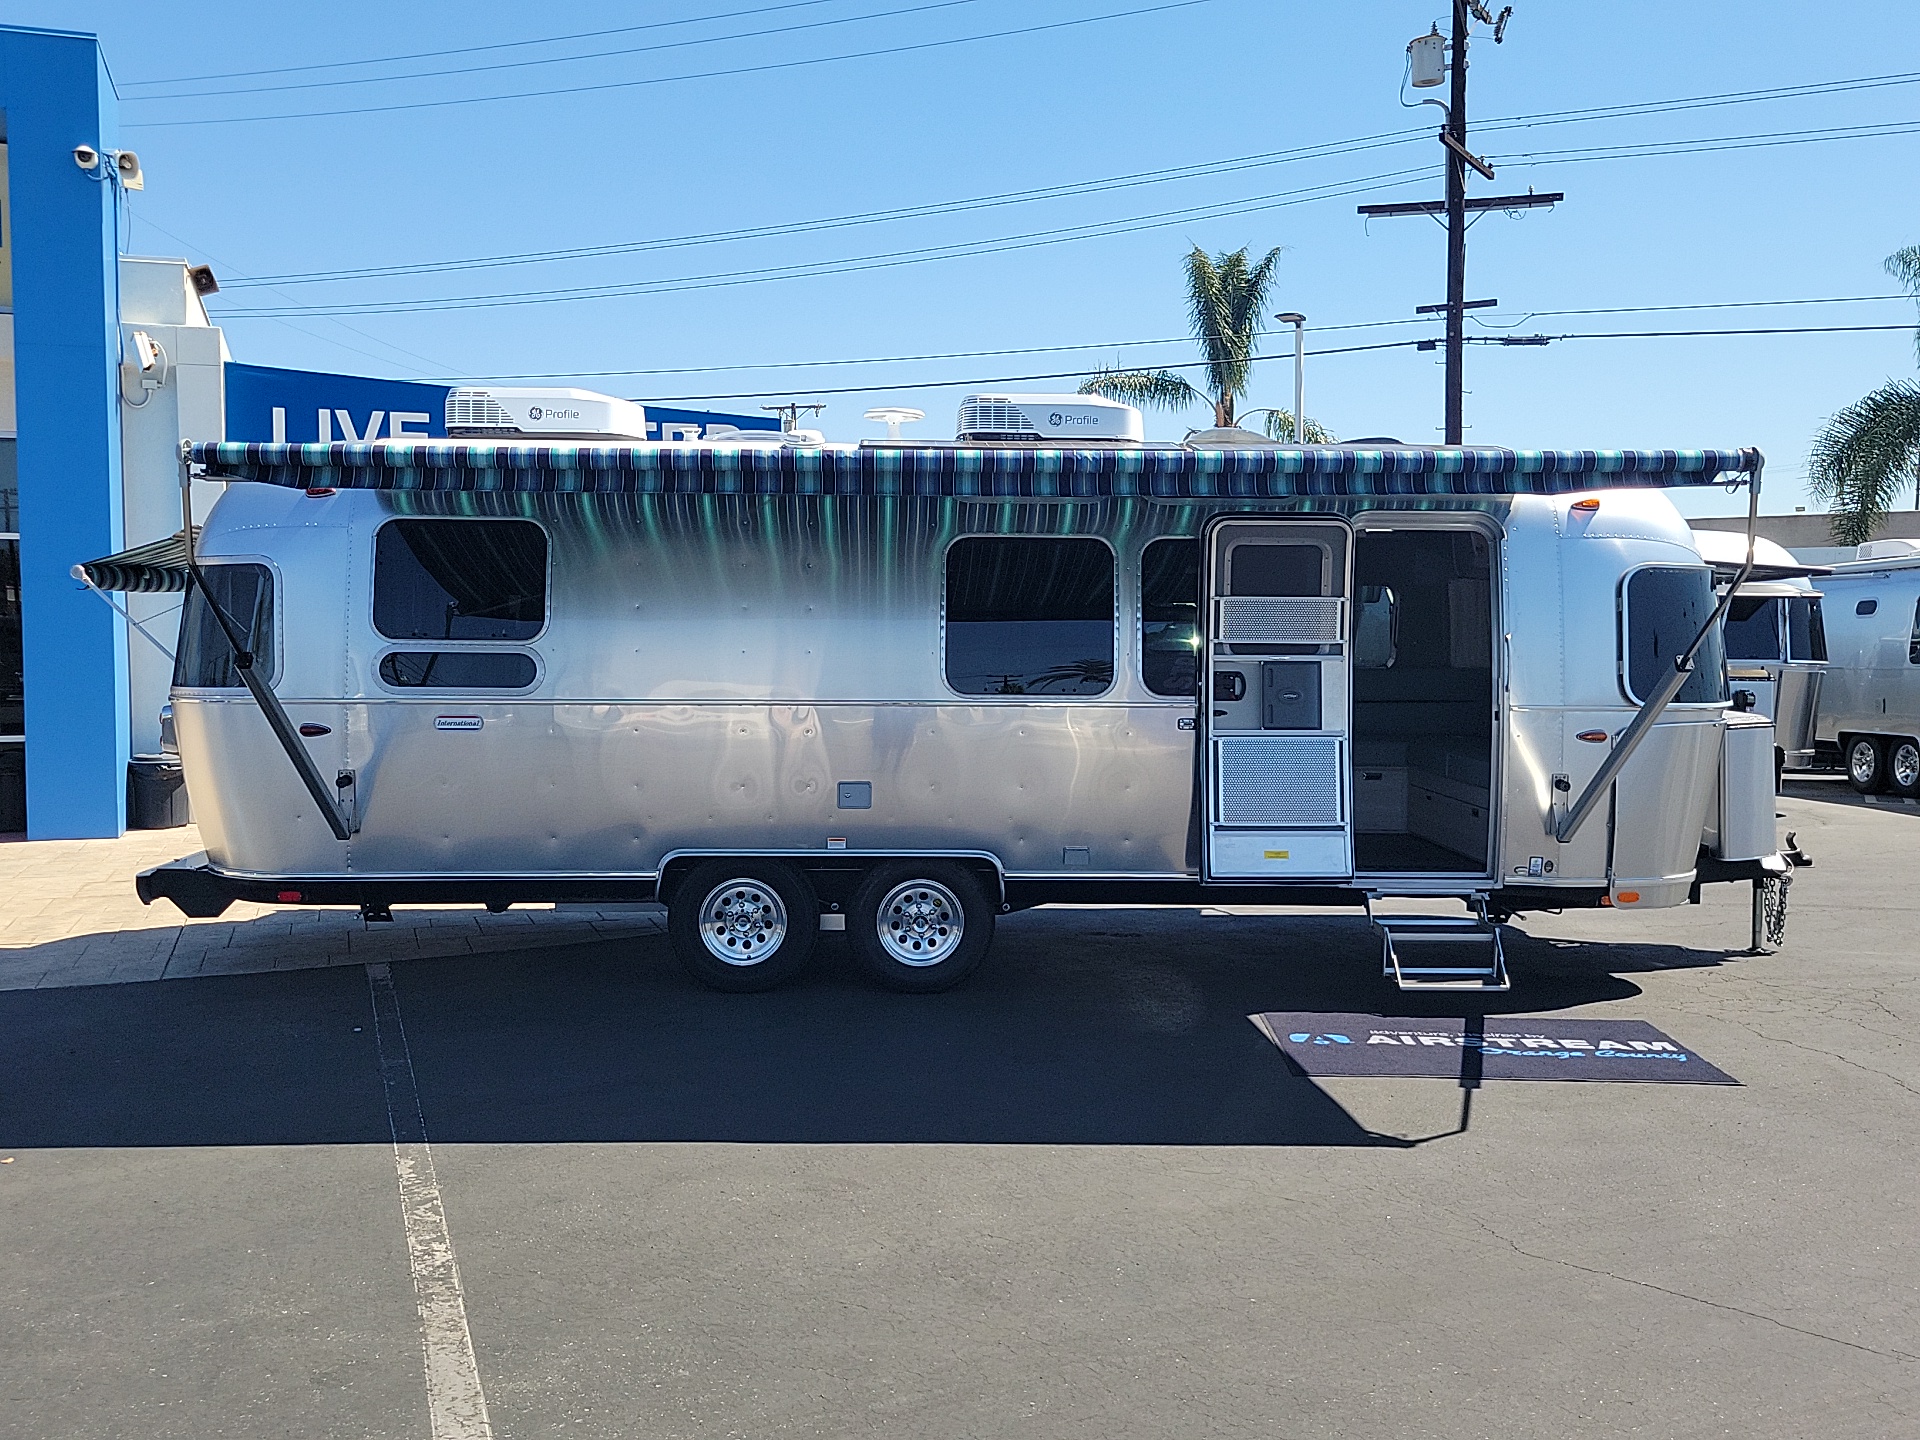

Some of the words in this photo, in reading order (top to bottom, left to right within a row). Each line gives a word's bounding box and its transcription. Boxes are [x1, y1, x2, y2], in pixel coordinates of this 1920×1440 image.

[545, 409, 580, 419] Profile
[1064, 415, 1099, 425] Profile
[272, 407, 430, 443] LIVE
[437, 719, 481, 727] International
[1366, 1034, 1679, 1052] AIRSTREAM
[1478, 1046, 1586, 1060] Orange
[1594, 1049, 1688, 1062] County
